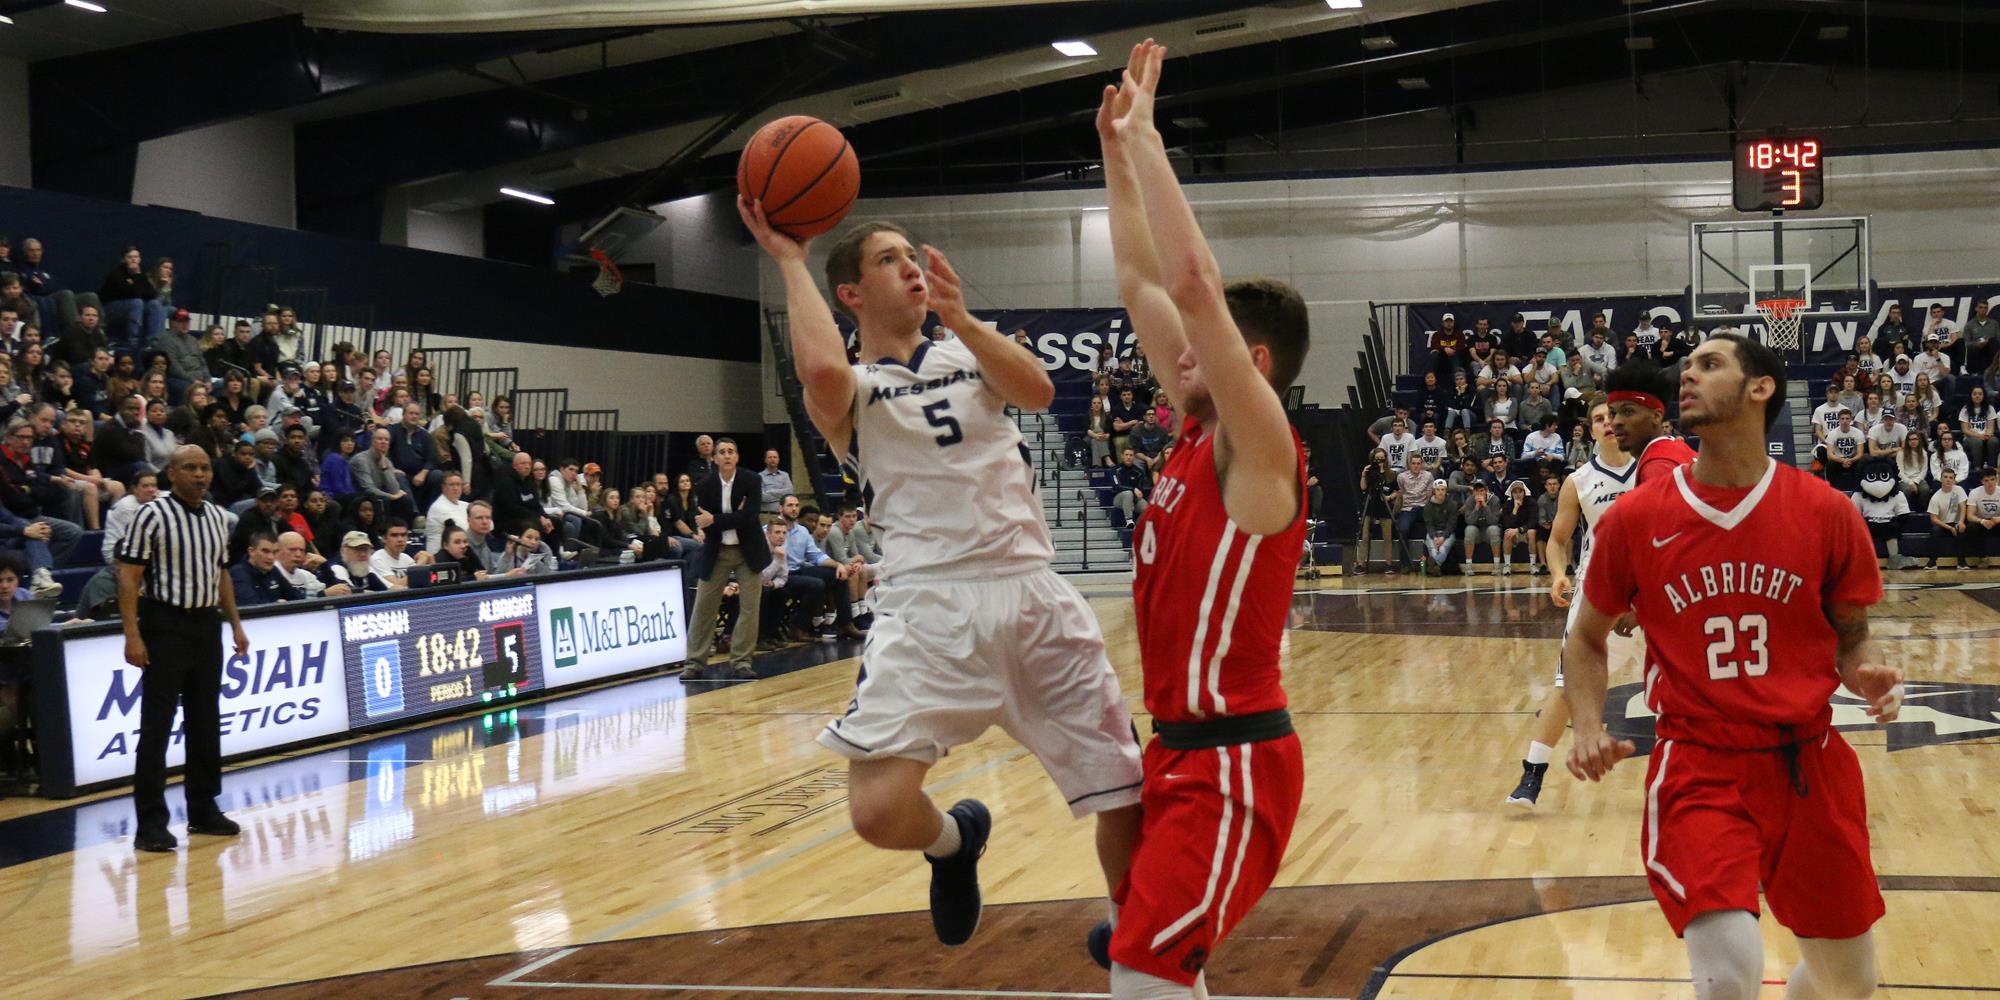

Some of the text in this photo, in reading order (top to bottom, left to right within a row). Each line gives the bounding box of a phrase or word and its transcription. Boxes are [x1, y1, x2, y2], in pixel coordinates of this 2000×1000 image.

[1749, 142, 1817, 169] 18:42
[1781, 170, 1800, 205] 3
[921, 398, 963, 447] 5
[1836, 438, 1856, 447] FEAR
[1420, 448, 1439, 457] FEAR
[1663, 561, 1803, 614] ALBRIGHT
[344, 610, 410, 642] MESSIAH
[478, 594, 534, 622] ALBRIGHT
[579, 601, 678, 655] M&T Bank
[416, 627, 483, 678] 18:42
[503, 634, 519, 674] 5
[1703, 614, 1769, 681] 23
[374, 657, 392, 699] 0
